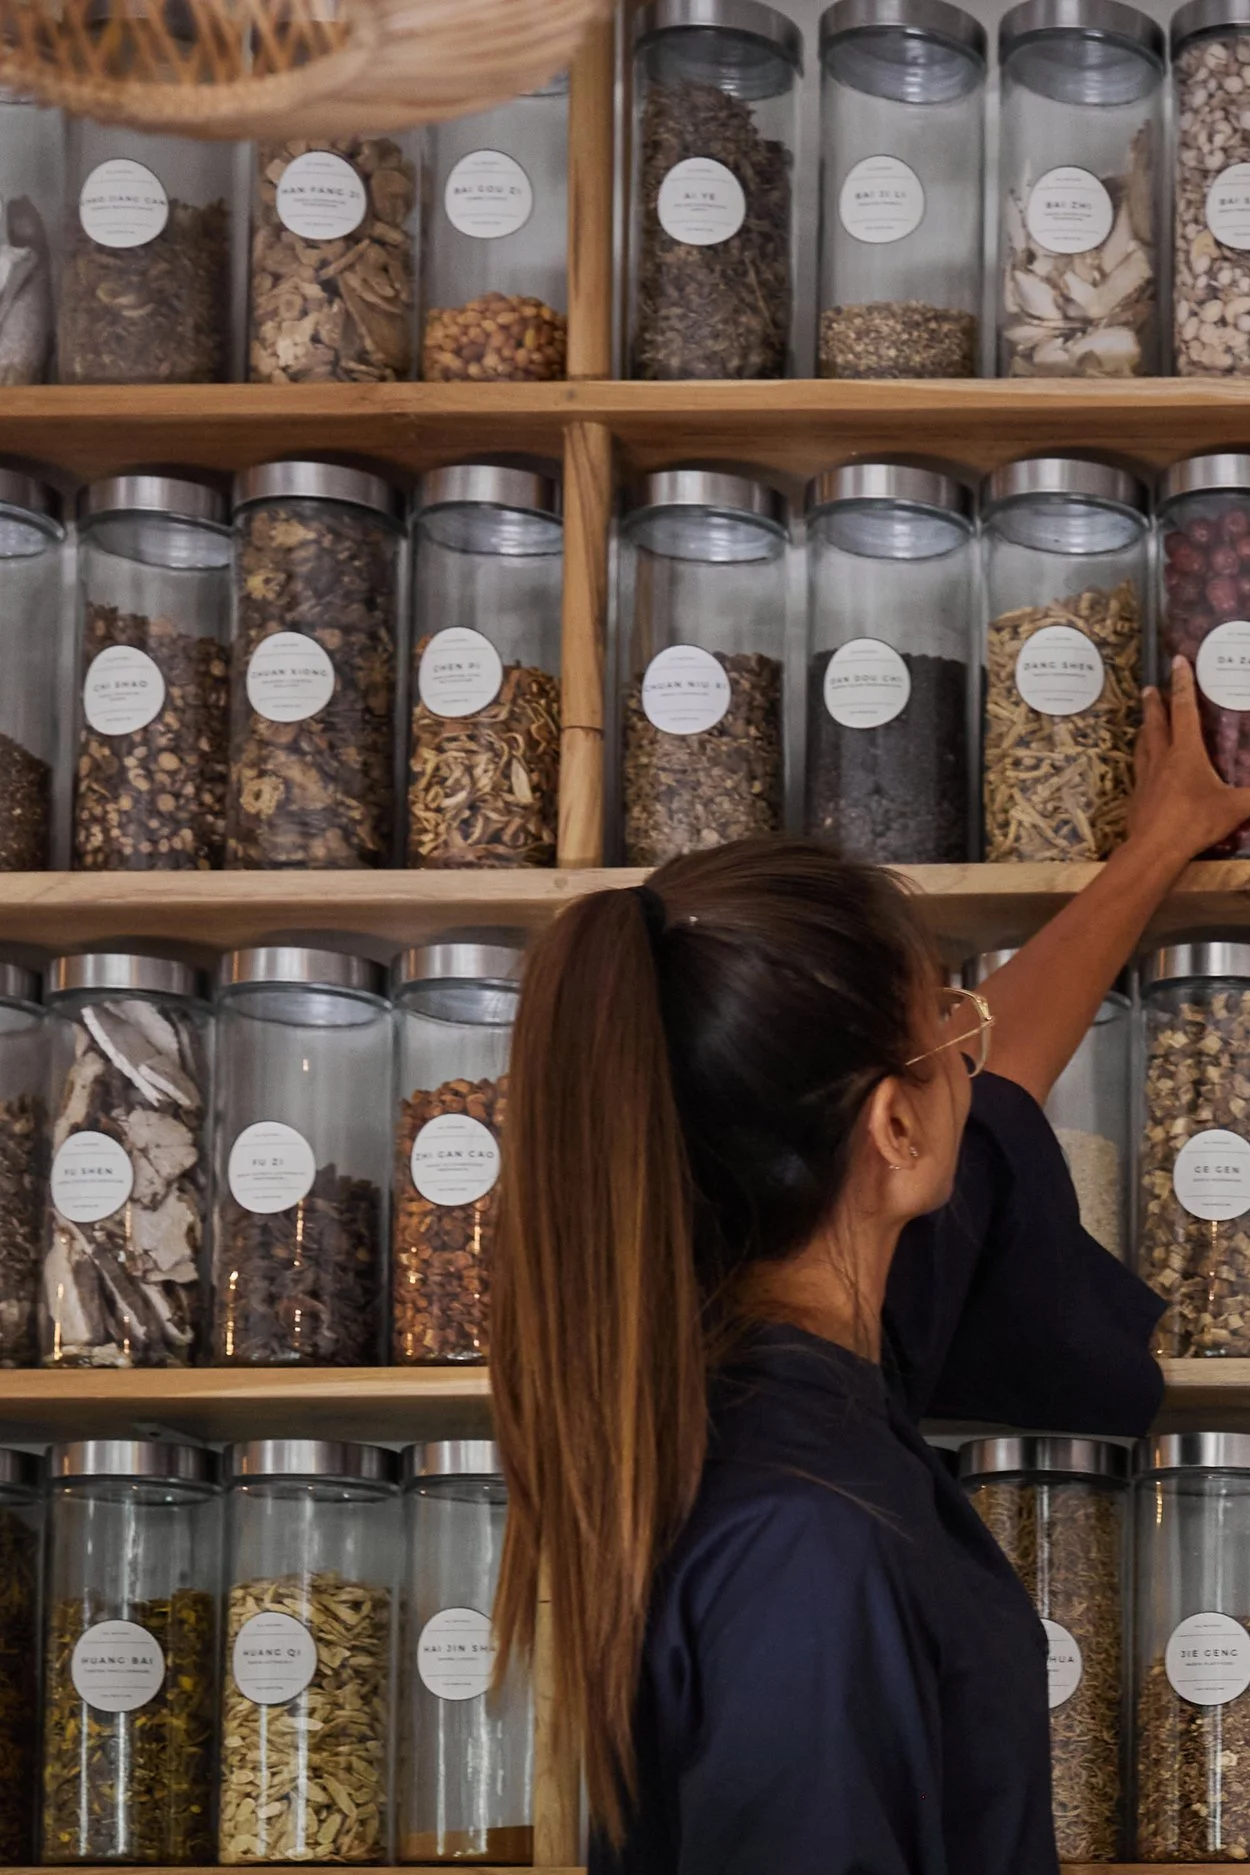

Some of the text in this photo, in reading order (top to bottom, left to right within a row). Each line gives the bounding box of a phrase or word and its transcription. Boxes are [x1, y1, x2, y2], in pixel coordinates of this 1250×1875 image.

[416, 1150, 494, 1160] ZHI GAN CAO
[271, 1158, 284, 1166] ZI
[1215, 1166, 1239, 1174] GEN
[447, 1644, 465, 1652] JIN
[287, 1649, 300, 1657] QI
[1181, 1649, 1238, 1658] JIE GENG
